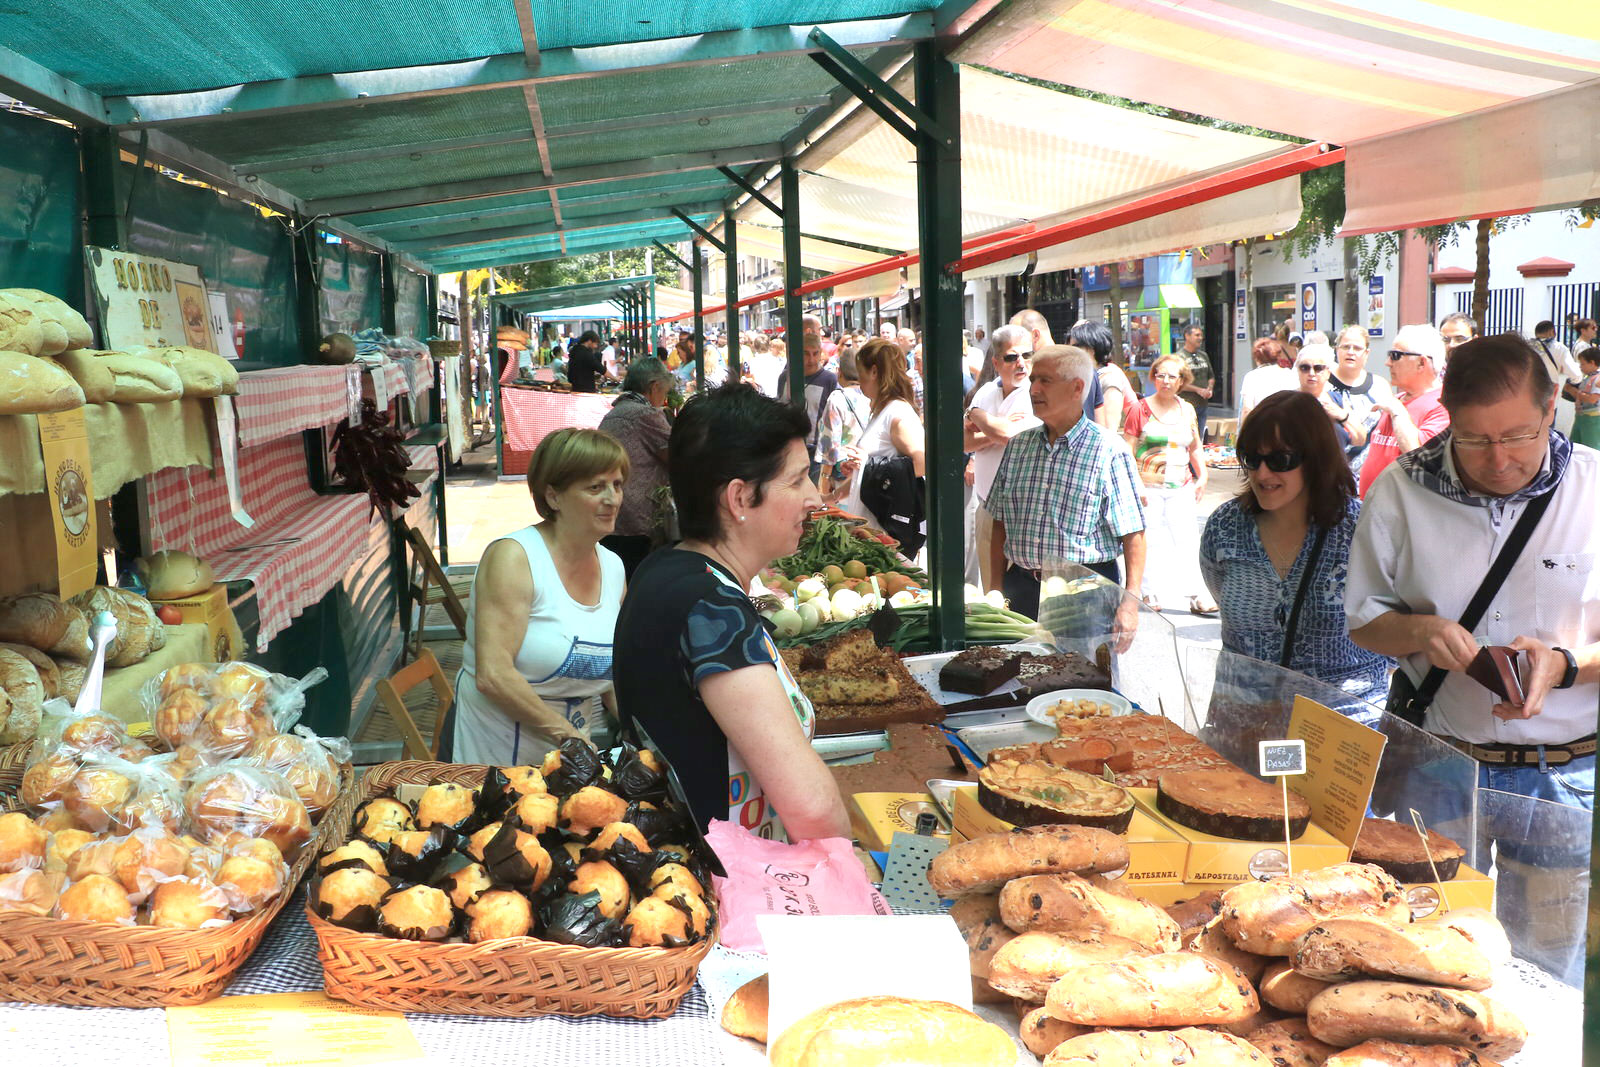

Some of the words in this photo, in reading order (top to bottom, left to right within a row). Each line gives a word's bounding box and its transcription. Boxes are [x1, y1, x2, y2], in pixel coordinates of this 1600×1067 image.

[113, 257, 172, 293] HORNO
[138, 298, 162, 329] DE
[1267, 759, 1291, 768] PASAS
[1128, 871, 1178, 880] ARTESANAL
[1194, 872, 1249, 881] REPOSTERIA
